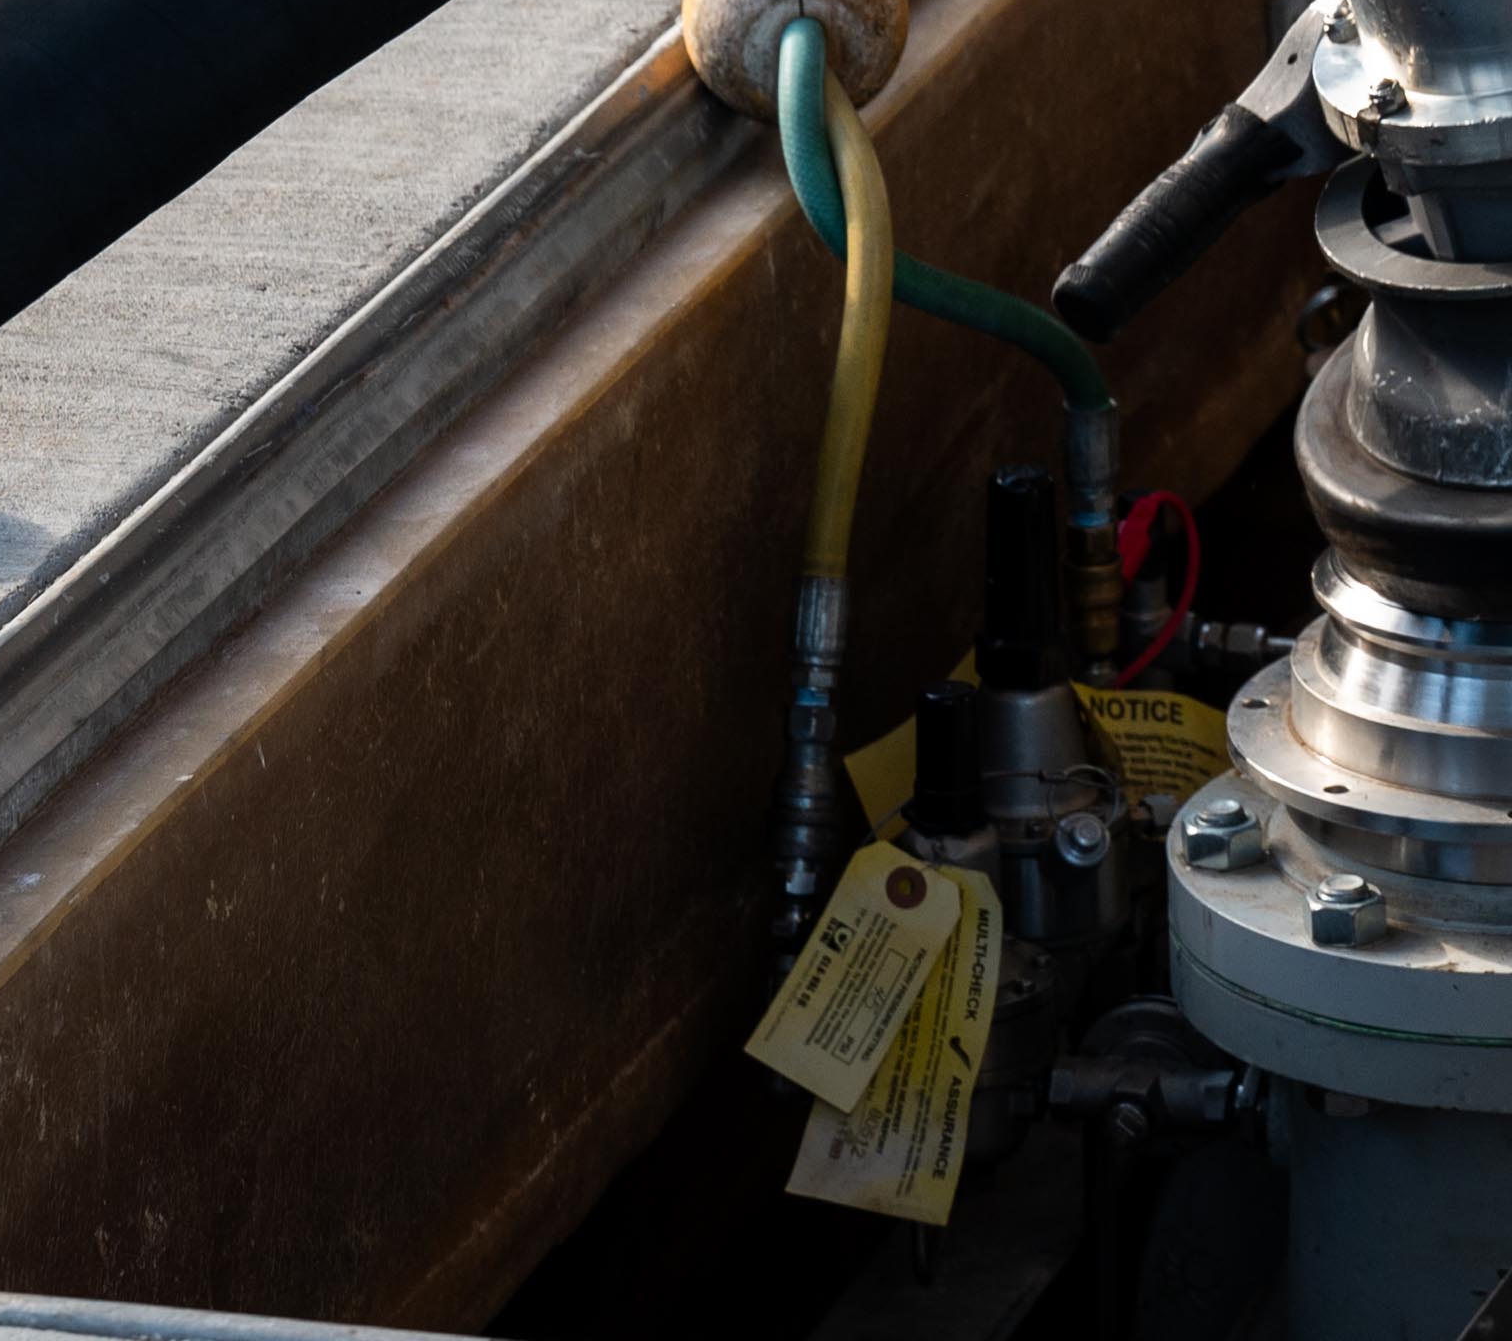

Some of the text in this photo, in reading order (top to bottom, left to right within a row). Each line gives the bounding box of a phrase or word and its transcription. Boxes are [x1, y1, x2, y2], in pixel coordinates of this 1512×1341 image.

[1088, 694, 1185, 726] NOTICE
[964, 907, 990, 1022] MULTI-CHECK
[931, 1074, 962, 1181] ASSURANCE
